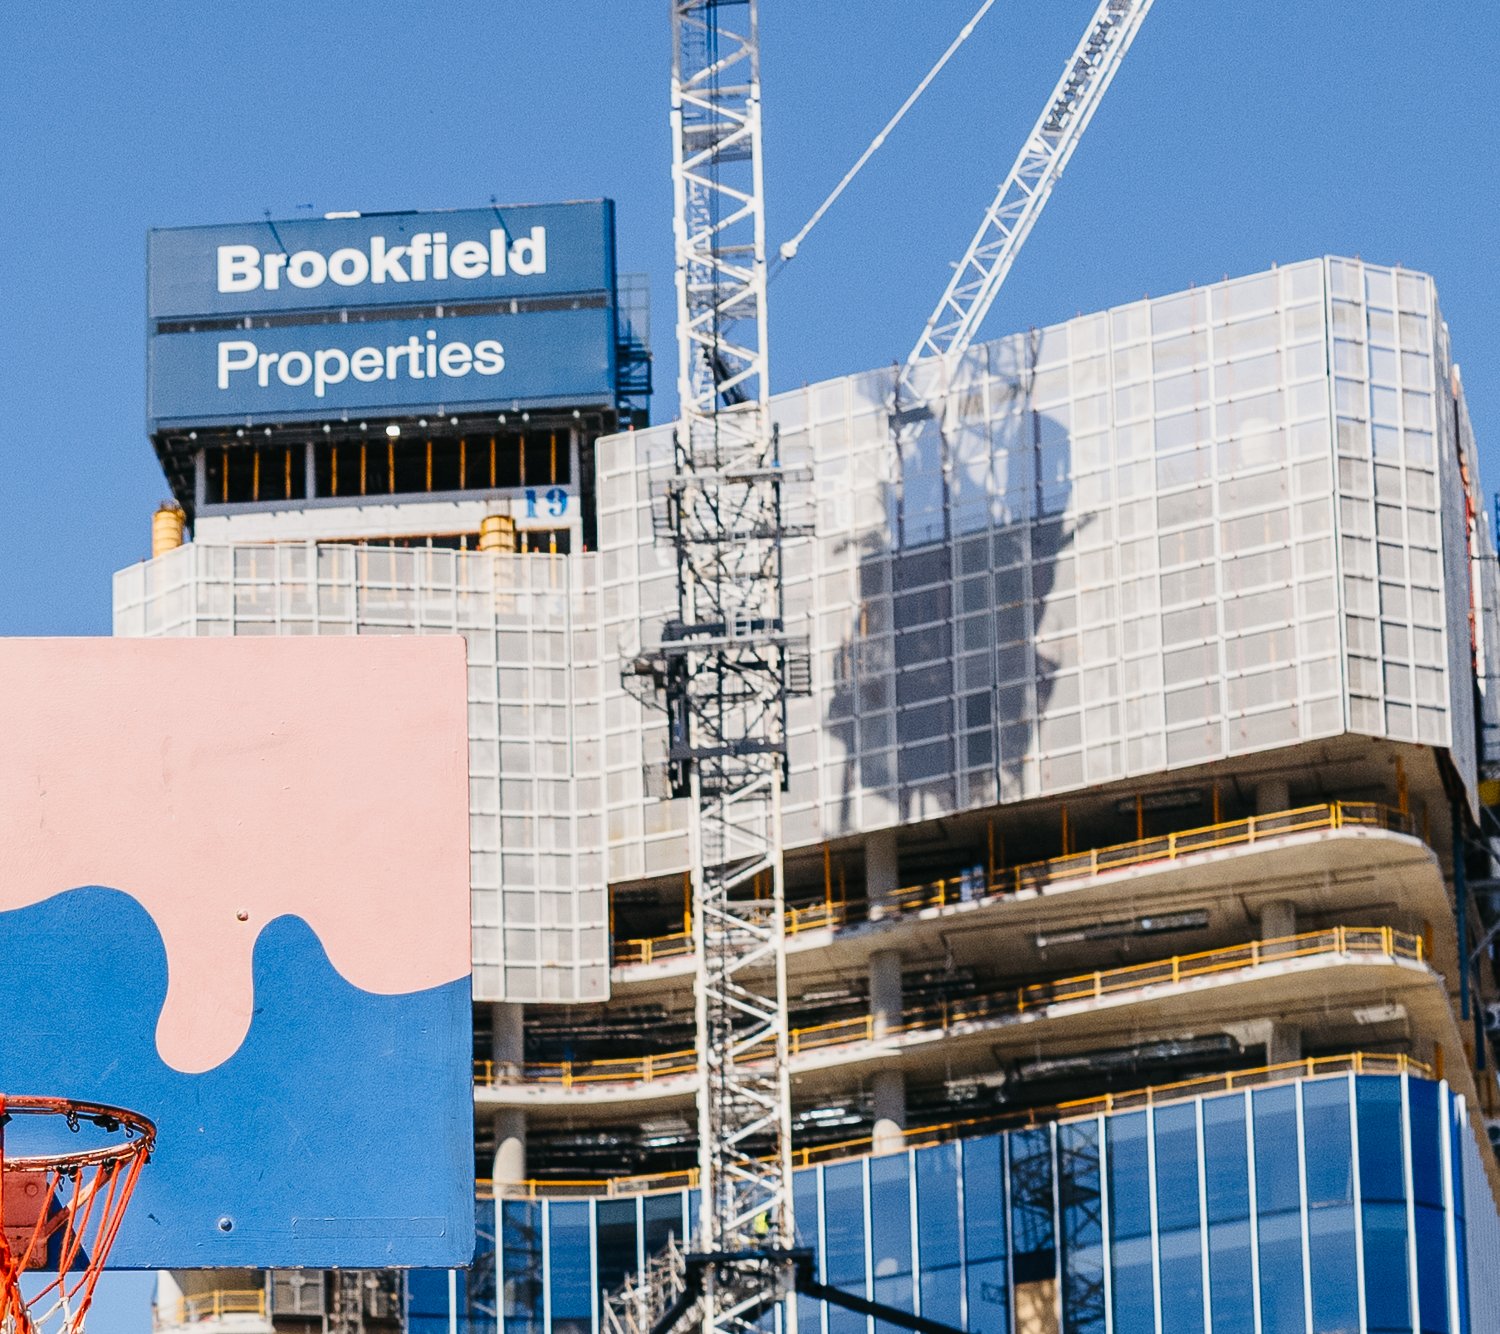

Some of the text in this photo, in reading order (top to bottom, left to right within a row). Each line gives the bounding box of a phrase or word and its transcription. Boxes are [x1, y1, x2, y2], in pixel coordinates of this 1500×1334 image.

[217, 226, 547, 294] Brookfield
[217, 329, 506, 398] Properties
[524, 487, 569, 519] 19
